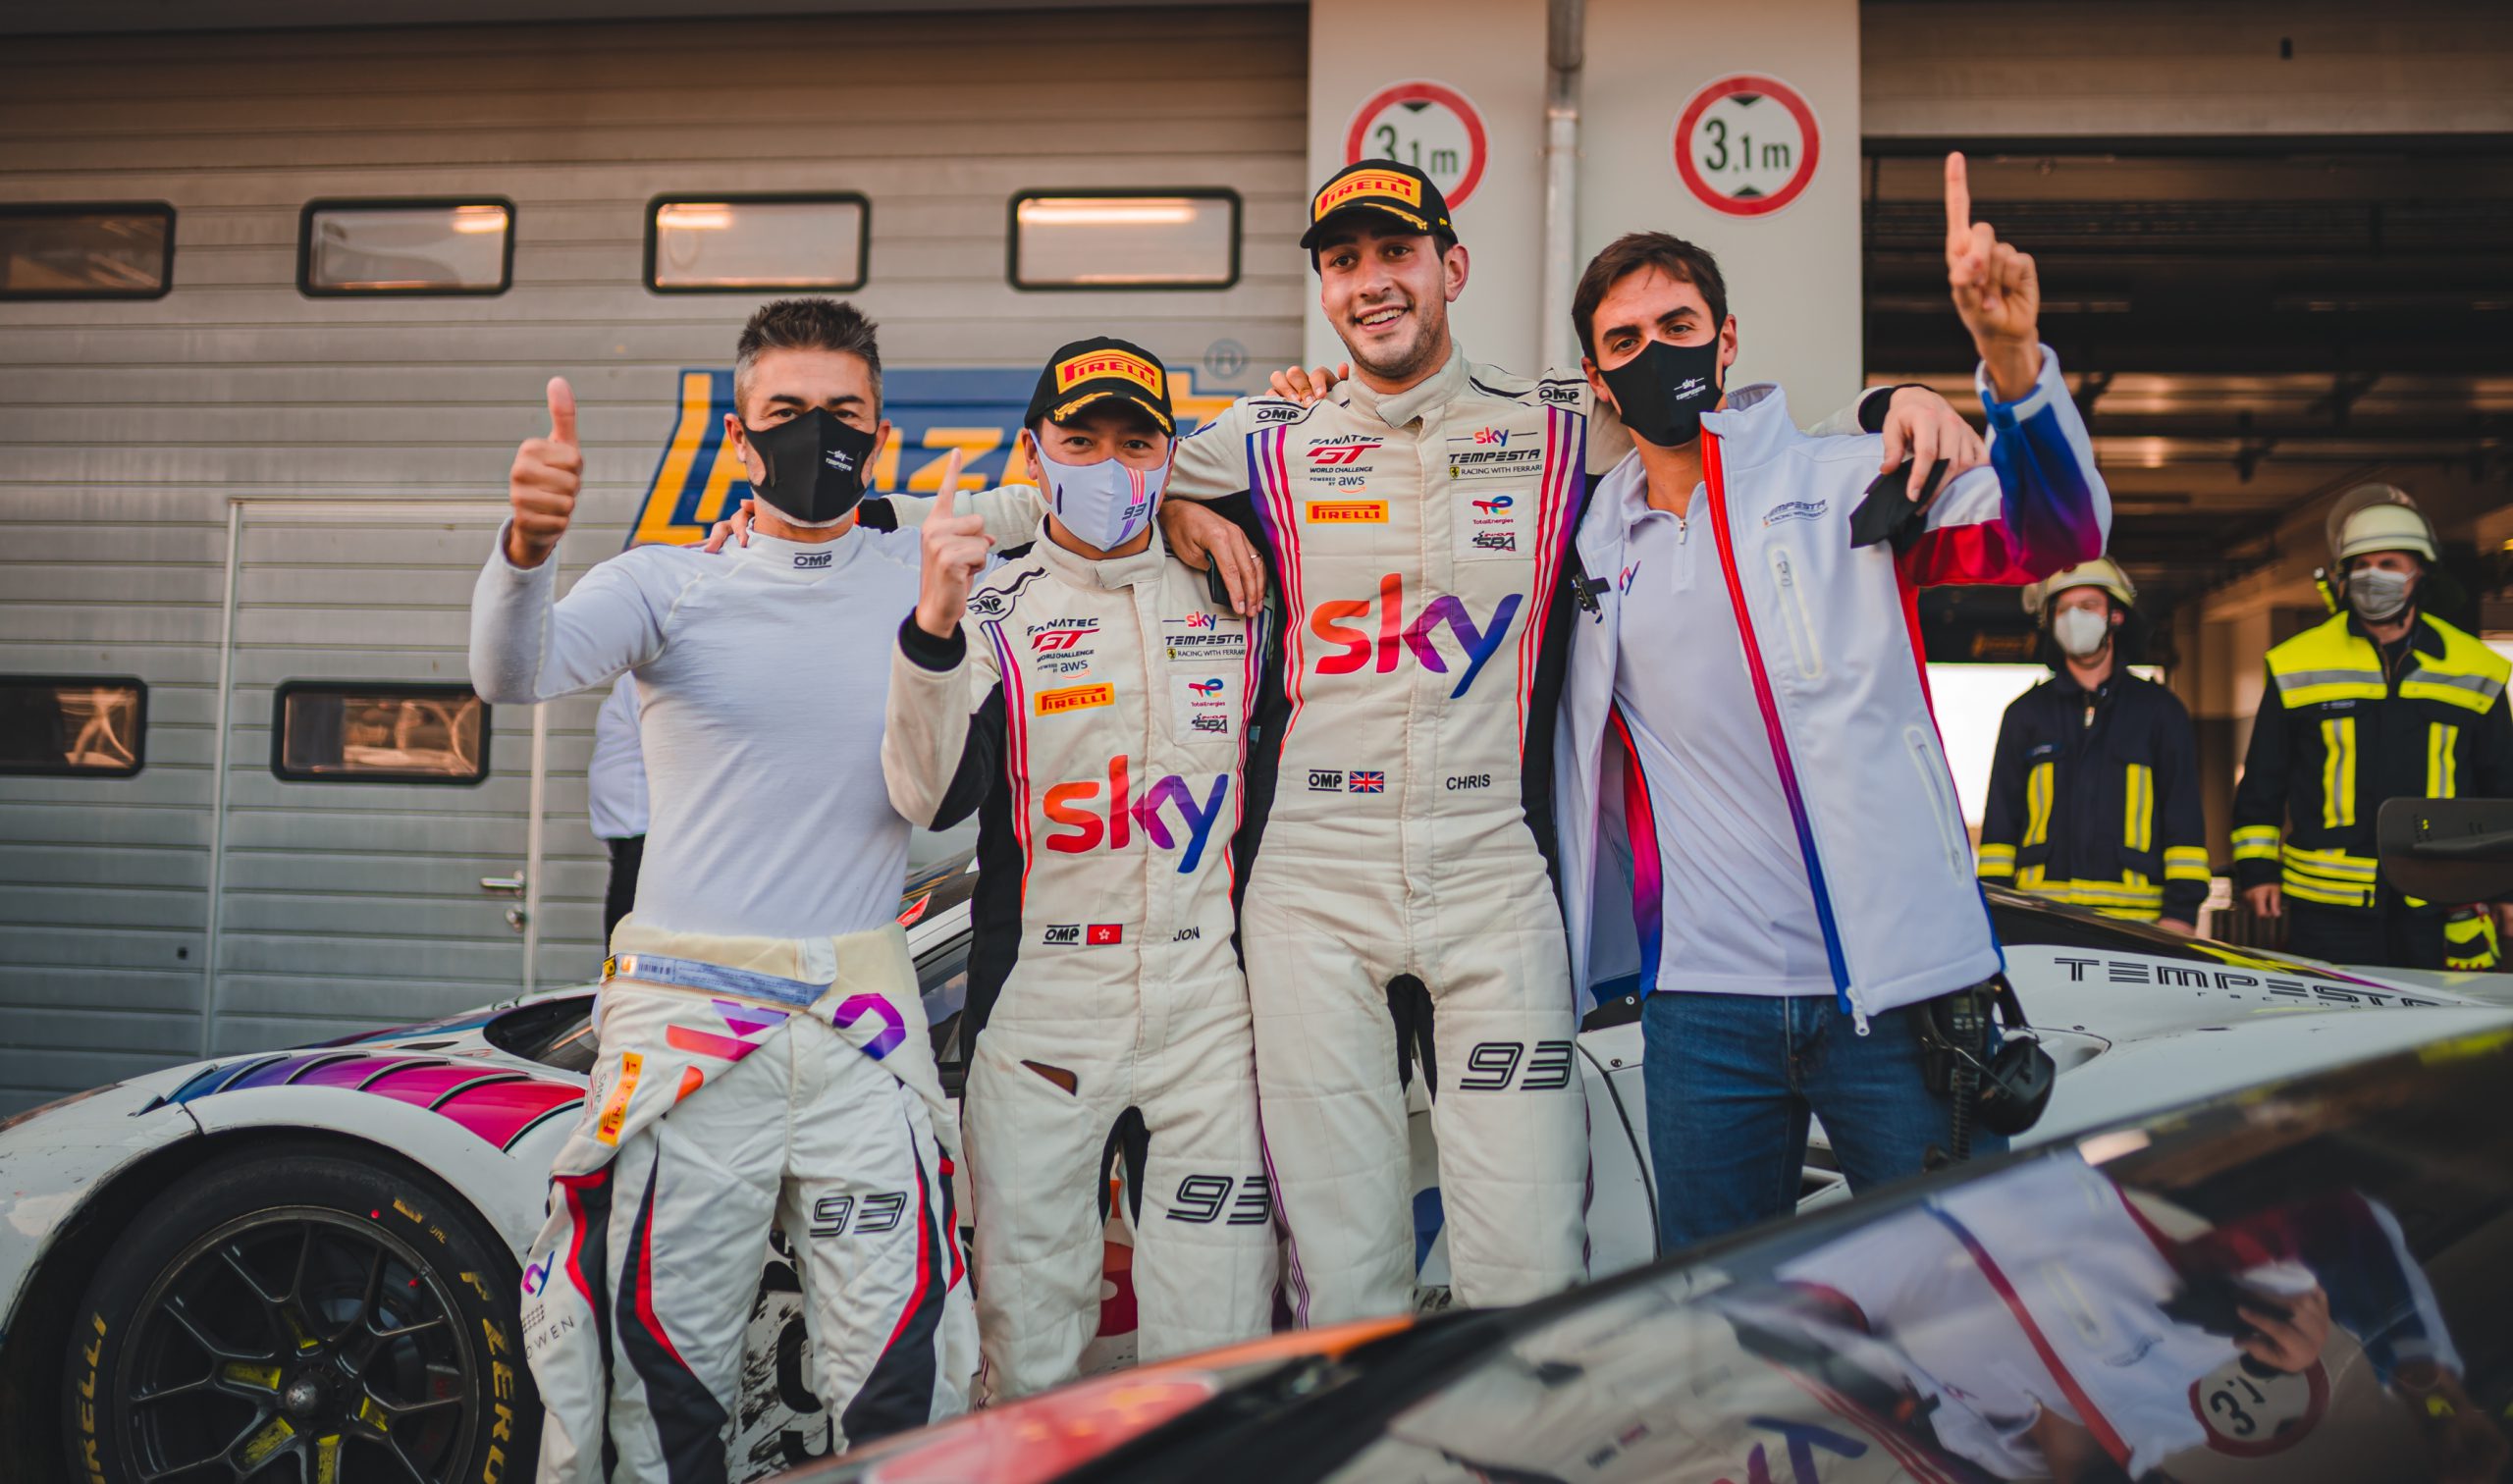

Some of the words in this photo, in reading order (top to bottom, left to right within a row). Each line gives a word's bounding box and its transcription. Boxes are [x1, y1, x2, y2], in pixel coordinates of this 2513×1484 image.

[1319, 173, 1412, 212] PIRELLI
[1064, 353, 1155, 388] PIRELLI
[1538, 388, 1579, 403] OMP
[1256, 408, 1299, 422] OMP
[1309, 434, 1384, 445] FANATEC
[1473, 426, 1510, 448] sky
[1306, 444, 1382, 464] GT
[1449, 449, 1541, 464] TEMPESTA
[1513, 463, 1543, 473] FERRARI
[1338, 476, 1365, 486] aws
[1122, 503, 1148, 521] 93
[1311, 504, 1380, 519] PIRELLI
[793, 553, 832, 567] OMP
[1027, 617, 1099, 637] FANATEC
[1185, 610, 1217, 631] sky
[1031, 628, 1100, 654] GT
[1165, 634, 1244, 646] TEMPESTA
[1310, 572, 1524, 700] sky
[1060, 660, 1089, 673] aws
[1042, 687, 1106, 711] PIRELLI
[1308, 771, 1343, 790] OMP
[1446, 773, 1491, 790] CHRIS
[1043, 754, 1229, 874] sky
[1043, 927, 1080, 942] OMP
[1172, 926, 1201, 942] JON
[1460, 1041, 1573, 1090] 93
[603, 1060, 638, 1137] PIRI
[1165, 1174, 1271, 1225] 93
[809, 1191, 908, 1239] 93
